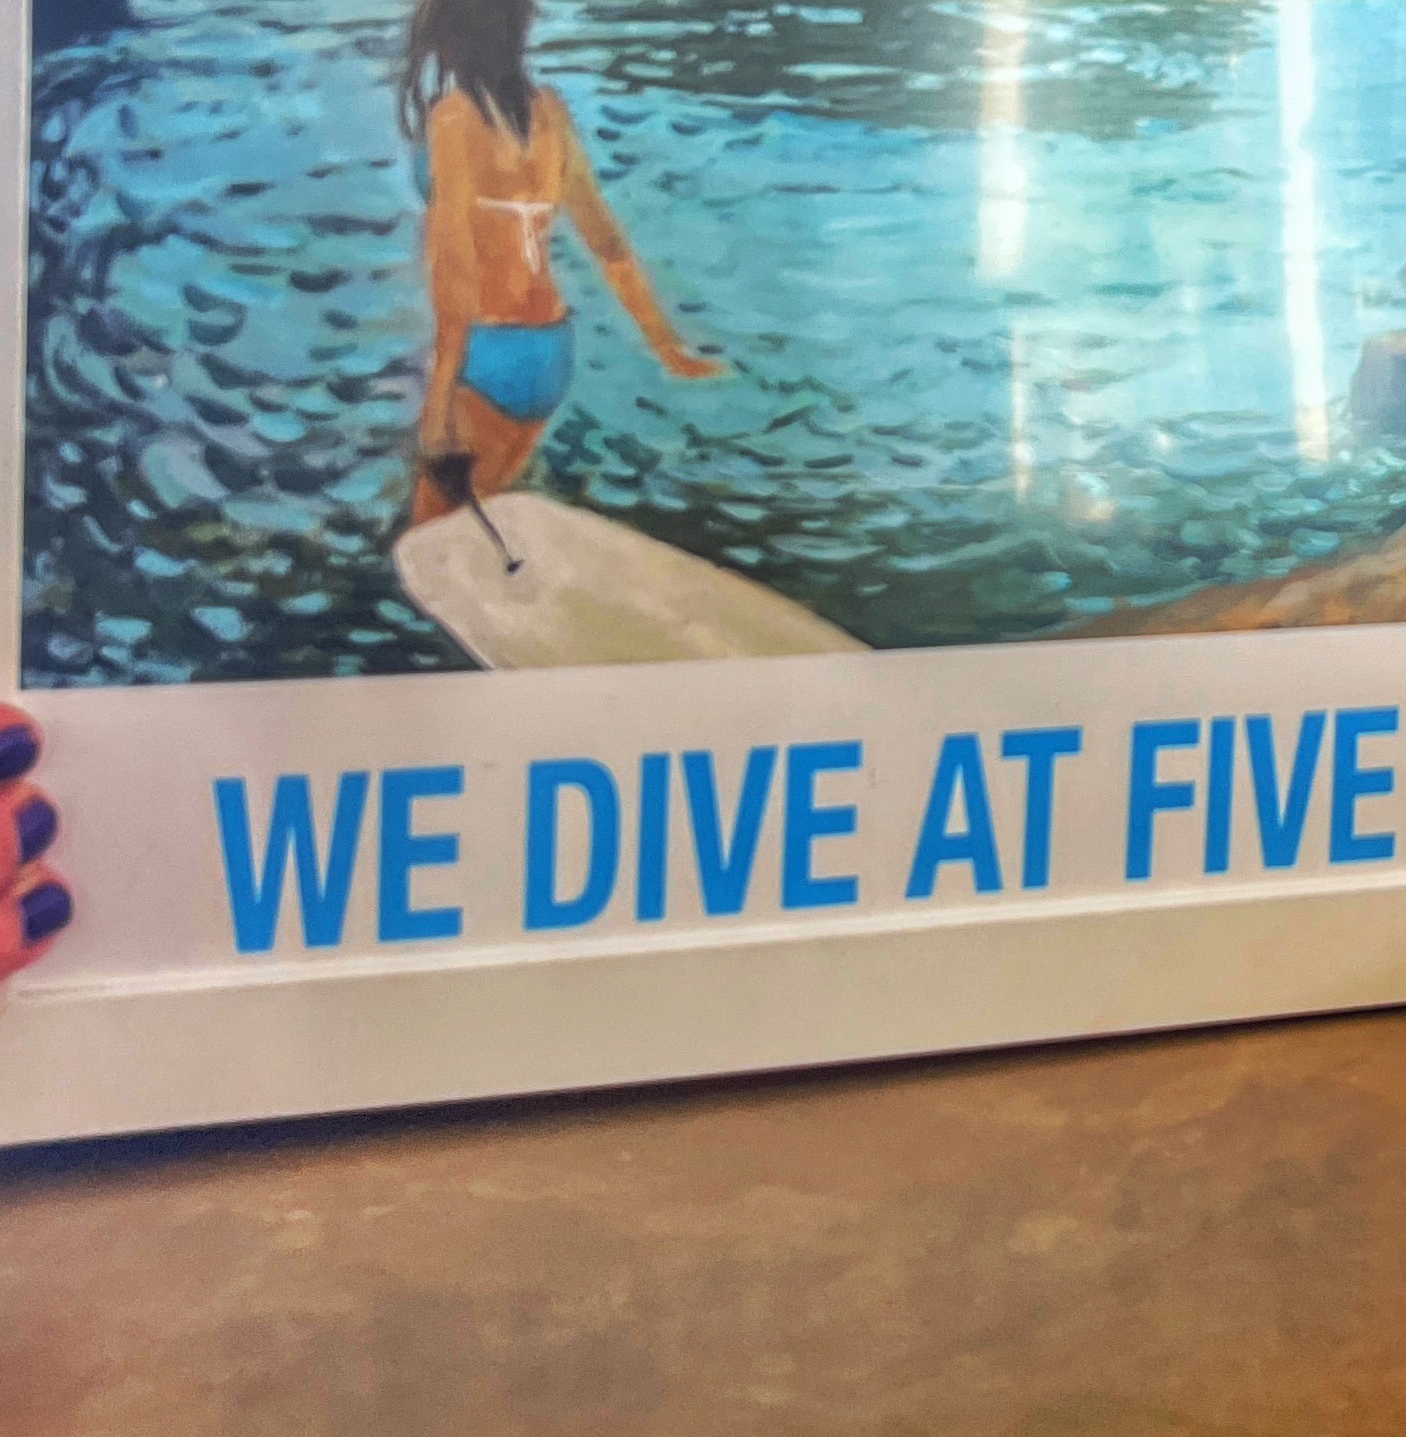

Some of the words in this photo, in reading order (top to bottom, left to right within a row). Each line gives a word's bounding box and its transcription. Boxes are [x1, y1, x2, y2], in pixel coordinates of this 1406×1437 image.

[213, 766, 462, 953] WE
[524, 741, 862, 931] DIVE
[905, 726, 1082, 899] AT
[1125, 707, 1398, 881] FIVE
